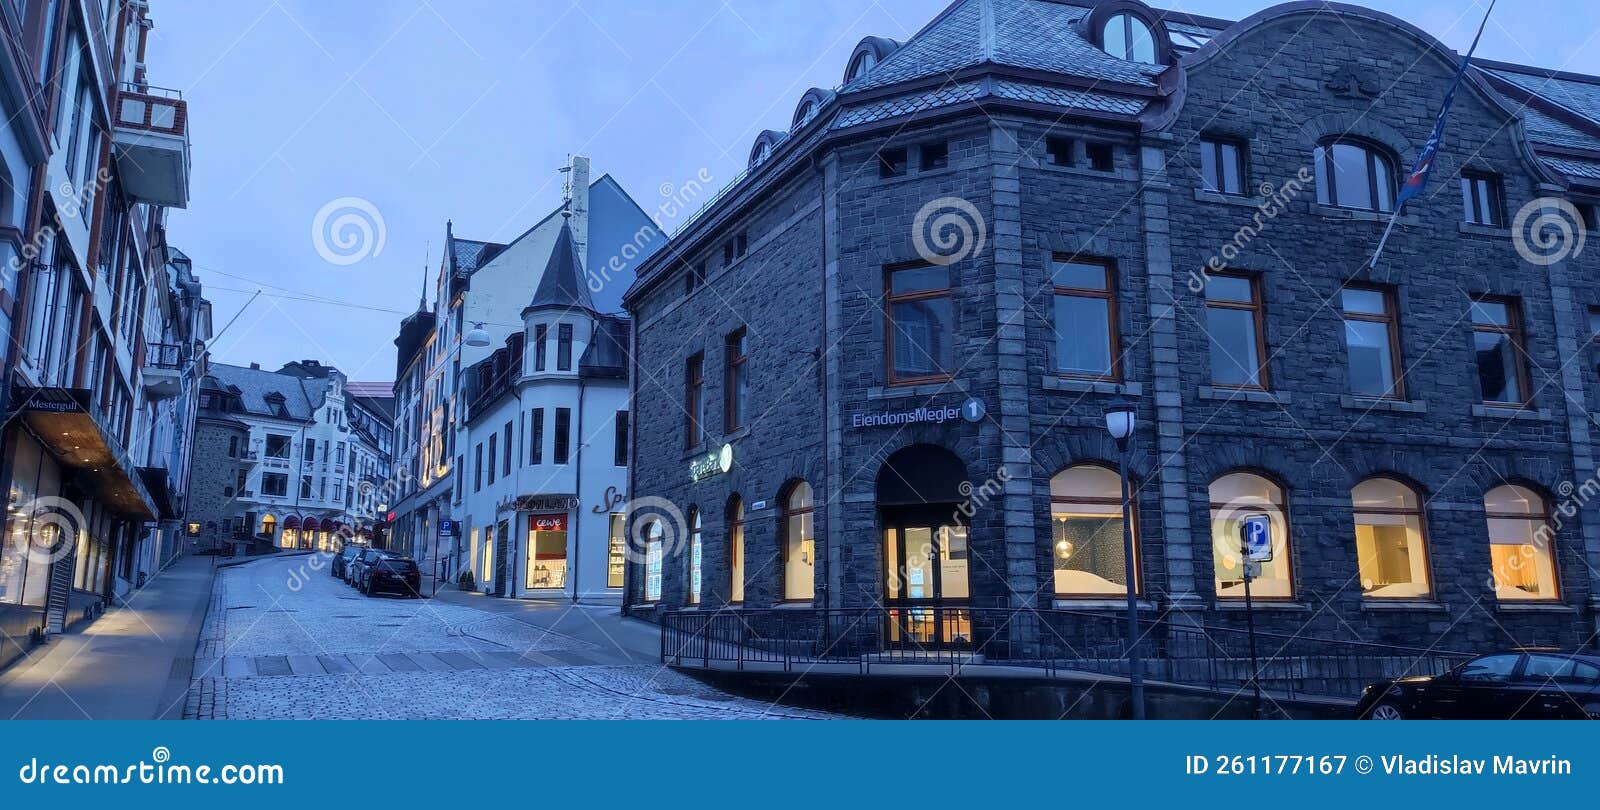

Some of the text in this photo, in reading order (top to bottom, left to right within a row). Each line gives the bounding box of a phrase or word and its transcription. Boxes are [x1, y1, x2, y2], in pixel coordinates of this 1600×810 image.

[28, 399, 77, 411] Mestergull
[852, 405, 961, 428] EiendomsMegler
[536, 518, 561, 527] cewe
[1252, 521, 1264, 542] P
